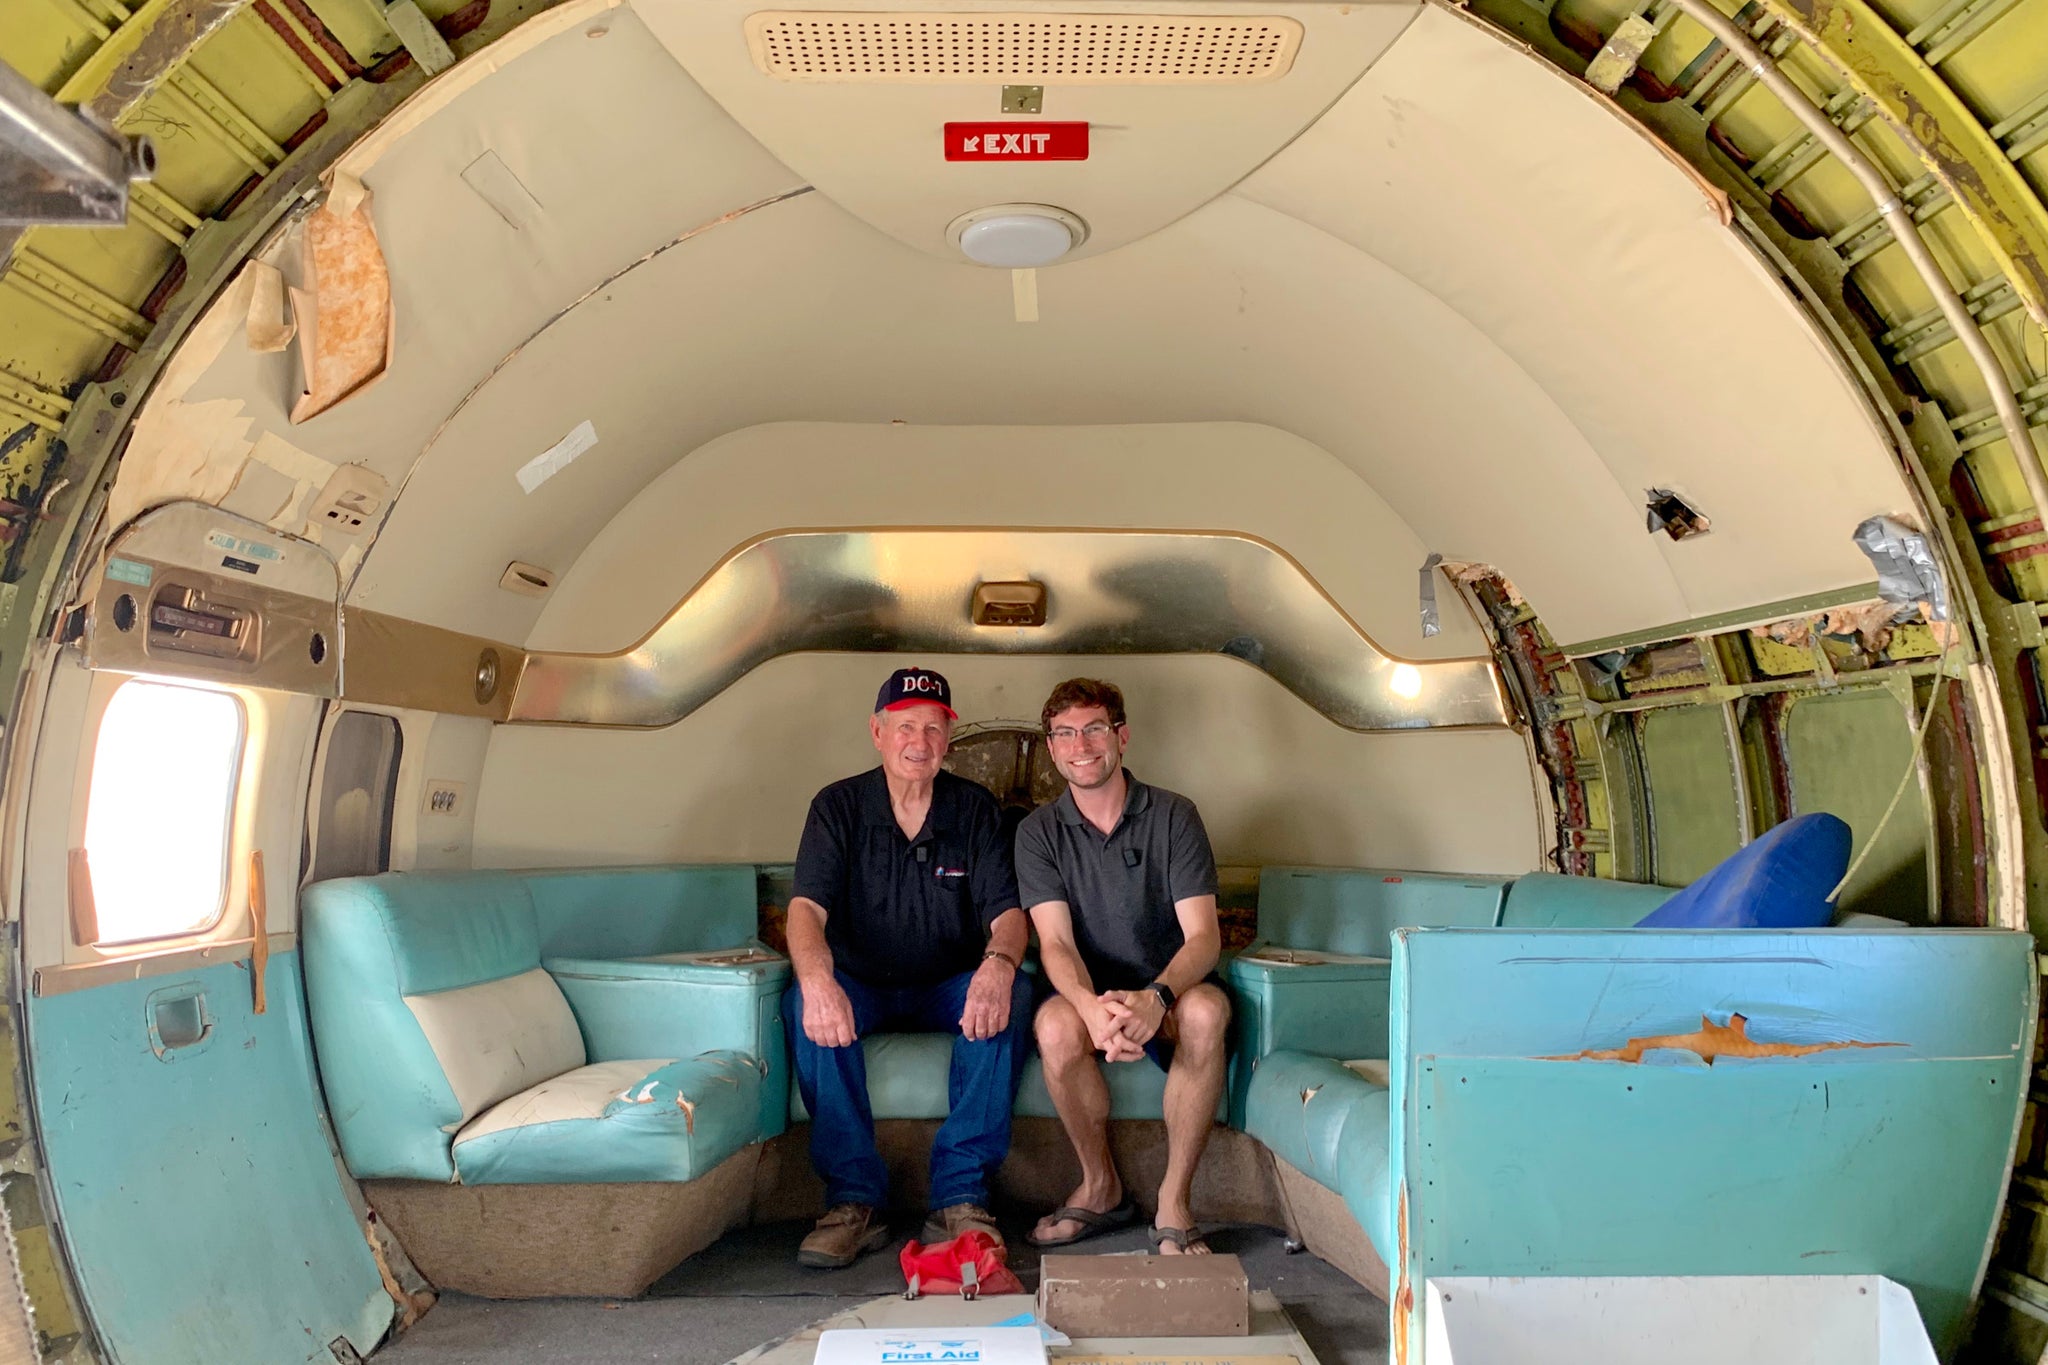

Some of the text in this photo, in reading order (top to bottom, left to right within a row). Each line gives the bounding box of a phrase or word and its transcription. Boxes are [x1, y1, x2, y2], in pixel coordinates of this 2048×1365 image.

[984, 133, 1051, 154] EXIT
[902, 675, 943, 696] DC-7
[882, 1351, 979, 1360] First Aid
